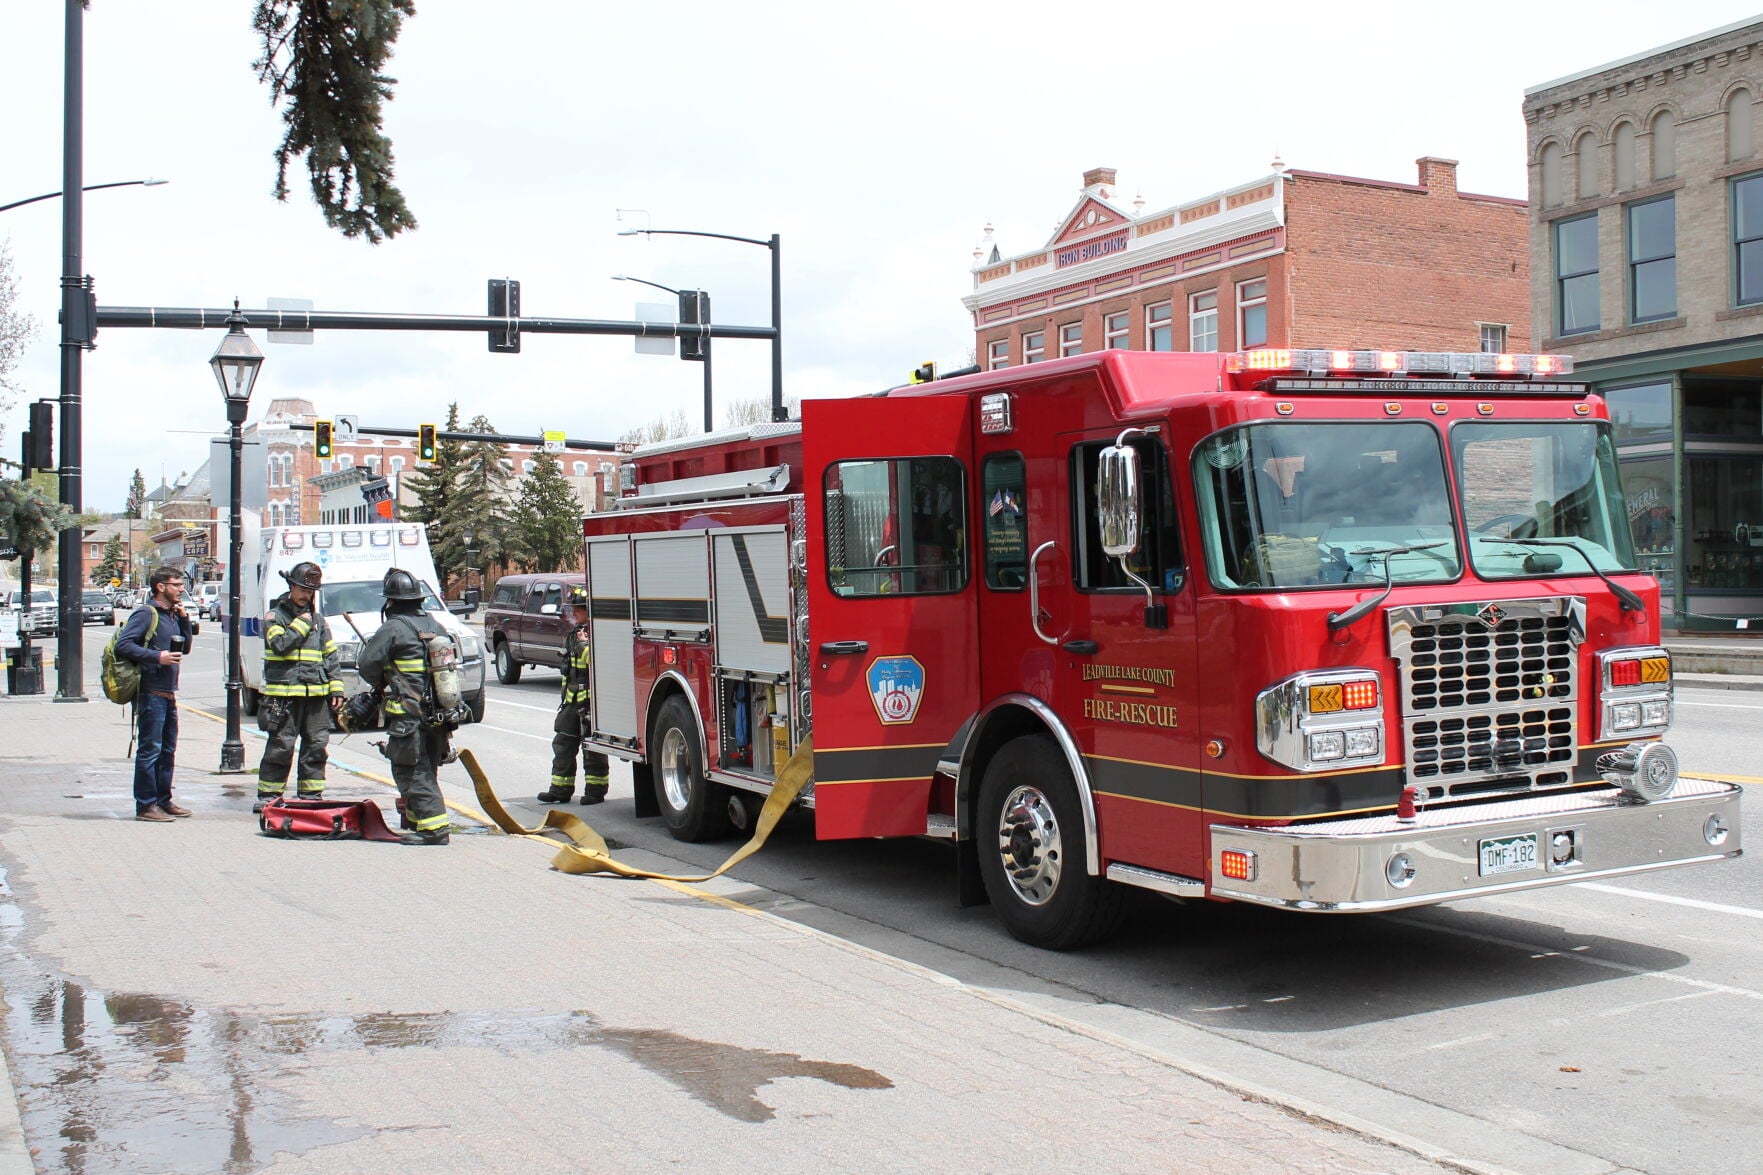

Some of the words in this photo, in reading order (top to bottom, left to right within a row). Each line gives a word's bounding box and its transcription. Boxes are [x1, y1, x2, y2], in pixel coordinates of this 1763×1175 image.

[1059, 249, 1080, 267] IRON
[1081, 236, 1127, 260] BUILDING
[1082, 663, 1121, 681] LEADVILLE
[1121, 666, 1141, 680] LAKE
[1142, 669, 1176, 688] COUNTY
[1083, 698, 1178, 728] FIRE-RESCUE
[1495, 864, 1524, 872] COLORADO
